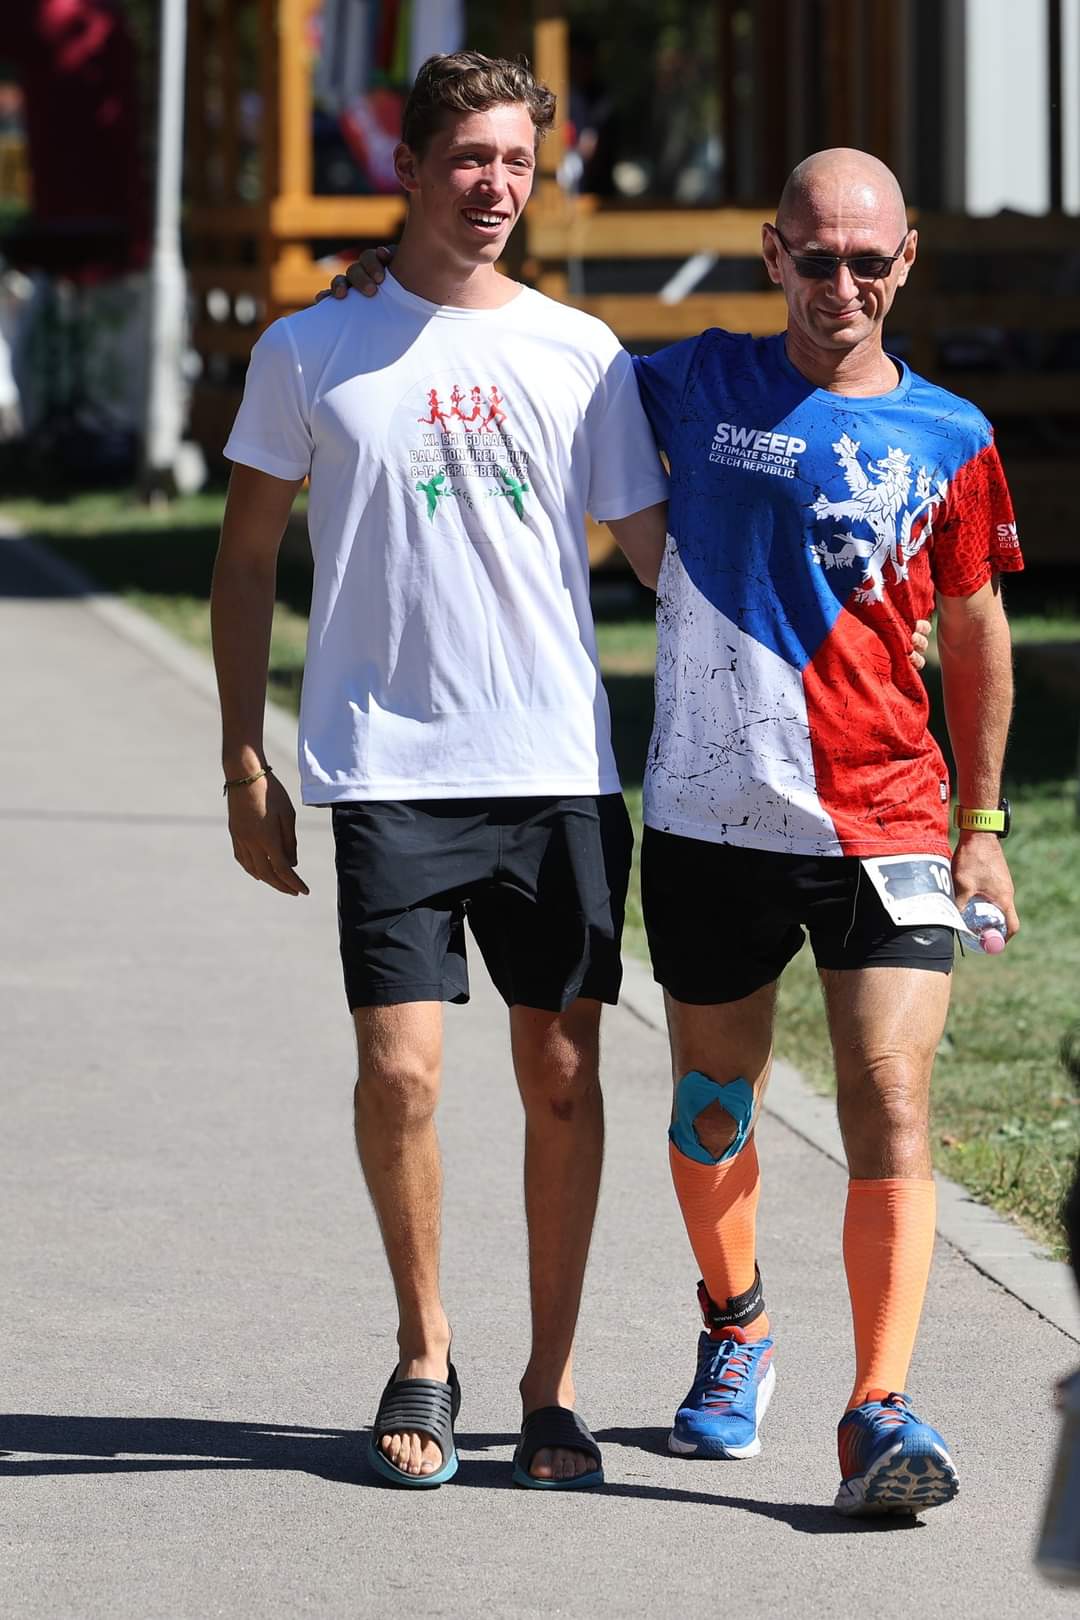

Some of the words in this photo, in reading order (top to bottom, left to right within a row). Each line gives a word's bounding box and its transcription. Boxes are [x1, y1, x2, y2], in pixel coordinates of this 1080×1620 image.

[465, 433, 481, 446] 6D
[483, 433, 513, 448] RACE
[713, 422, 807, 457] SWEEP
[709, 453, 741, 468] CZECH
[742, 461, 796, 479] REPUBLIC
[711, 442, 758, 459] ULTIMATE
[760, 453, 798, 468] SPORT
[411, 465, 436, 477] 8-14
